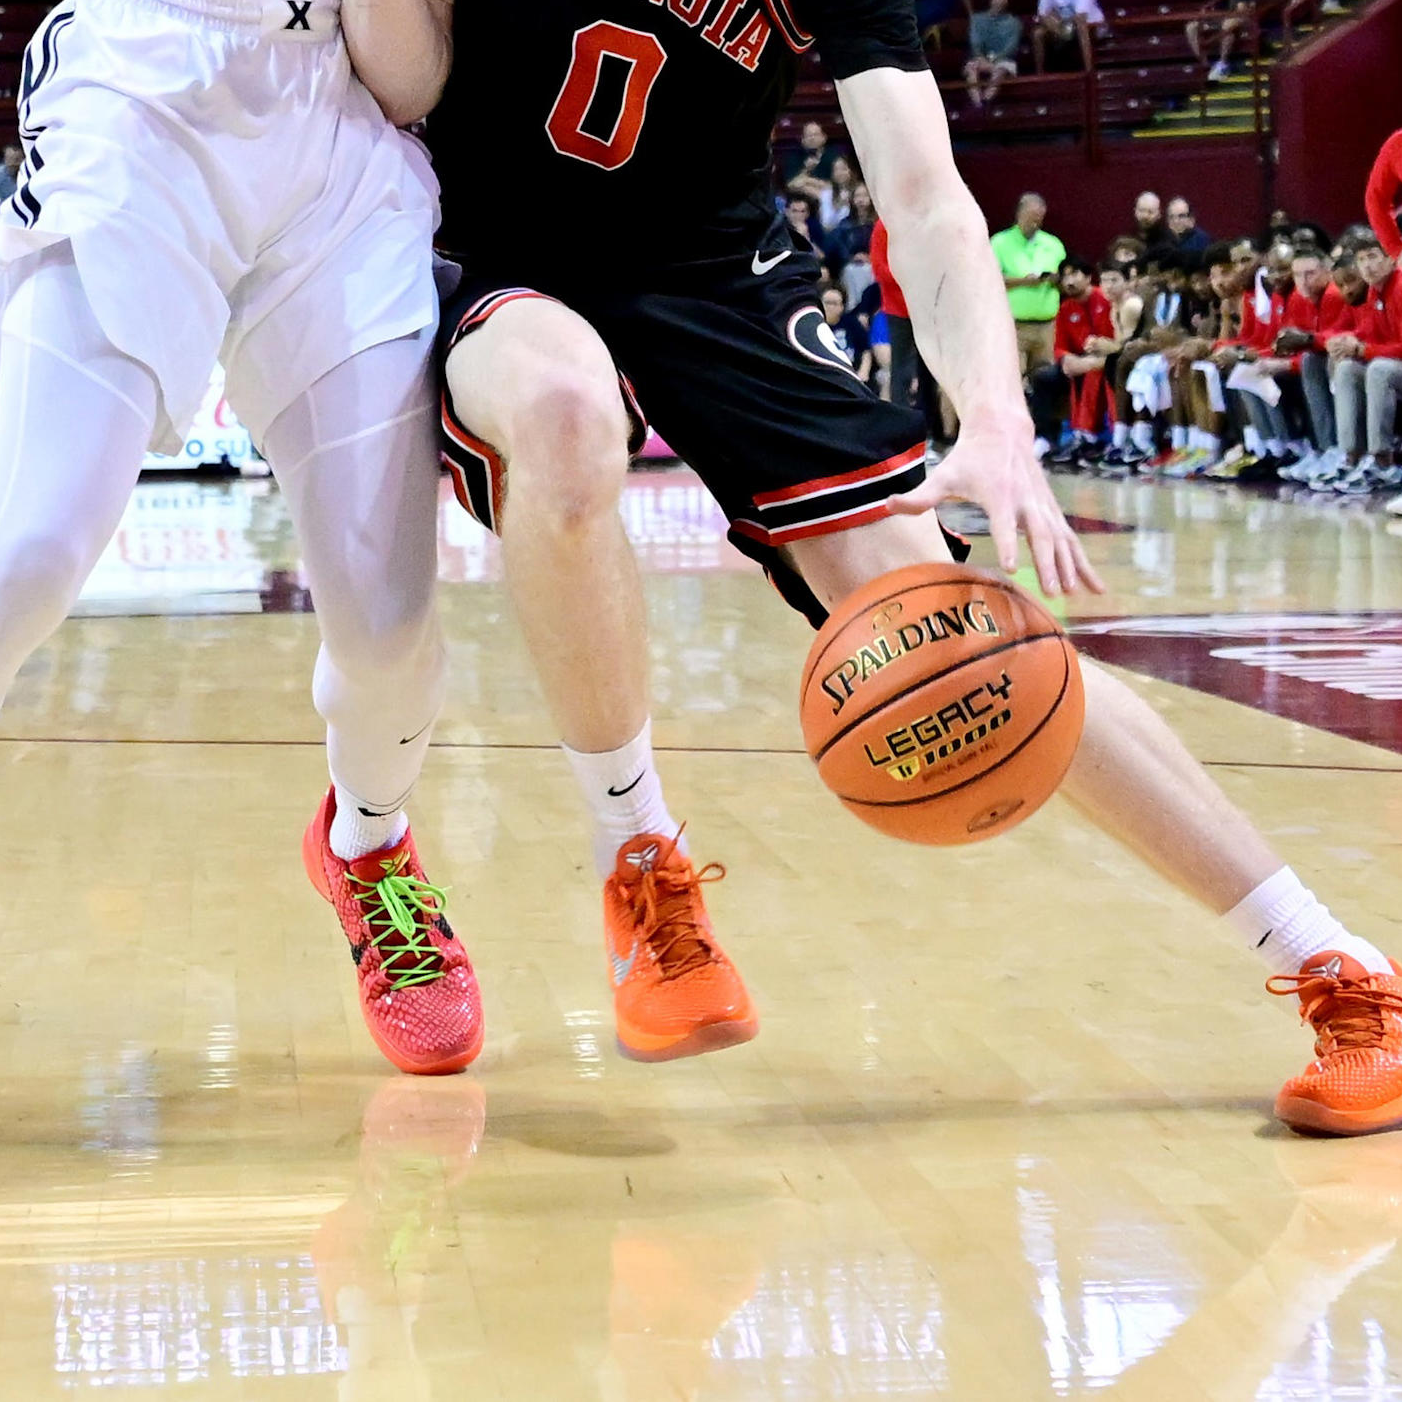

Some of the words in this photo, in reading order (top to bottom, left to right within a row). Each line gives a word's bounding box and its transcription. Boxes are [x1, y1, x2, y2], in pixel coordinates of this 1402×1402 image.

[285, 0, 313, 31] X
[546, 19, 668, 172] 0
[822, 599, 1000, 716] SPALDING
[863, 669, 1014, 767] LEGACY
[925, 708, 1012, 766] 1000
